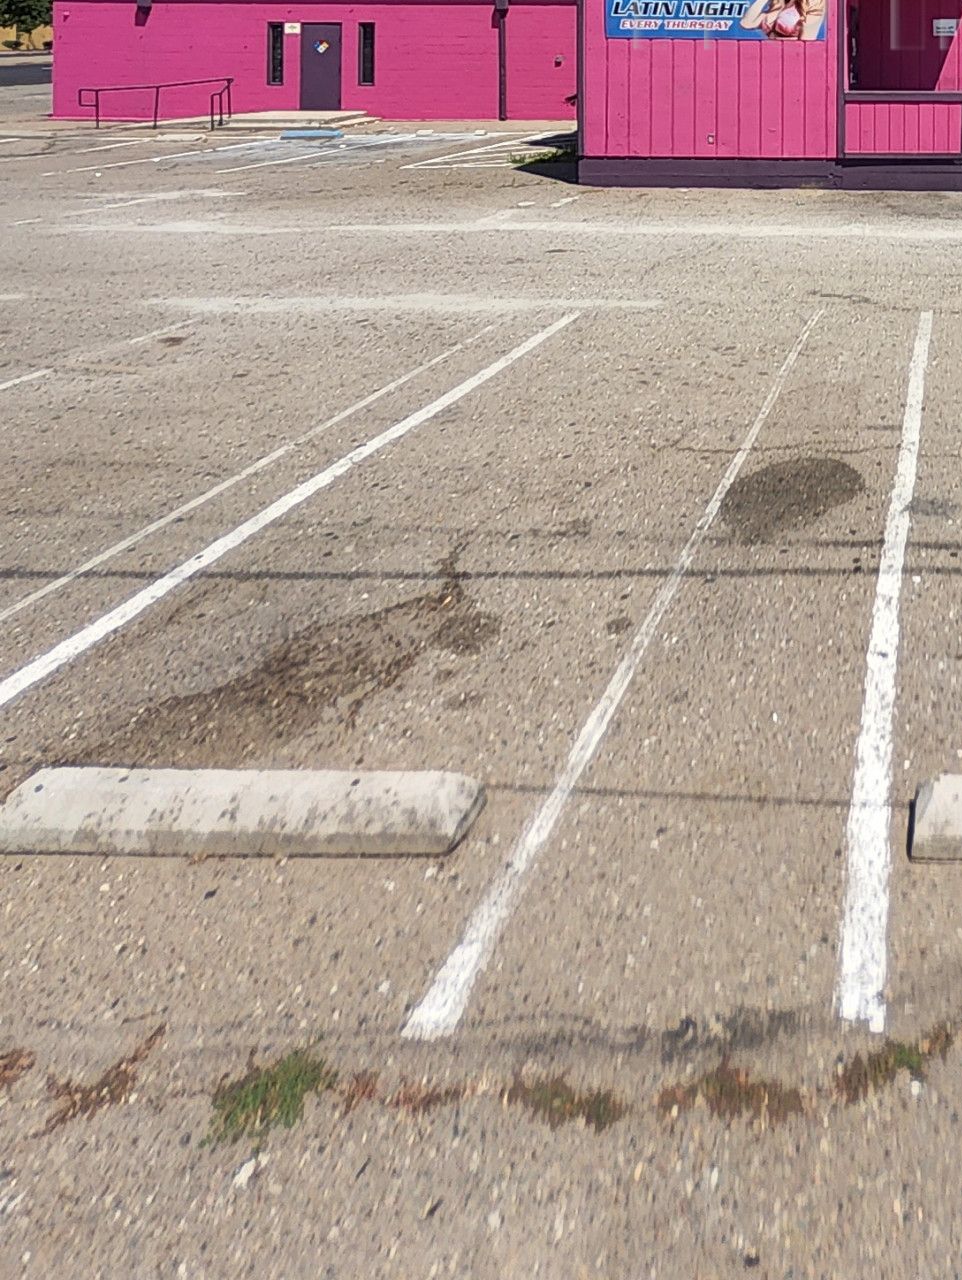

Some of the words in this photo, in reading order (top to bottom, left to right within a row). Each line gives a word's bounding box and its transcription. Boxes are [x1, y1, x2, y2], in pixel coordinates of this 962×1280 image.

[612, 0, 674, 17] LATIN
[679, 0, 748, 17] NIGHT
[619, 19, 661, 30] EVERY
[664, 18, 733, 30] THURSDAY
